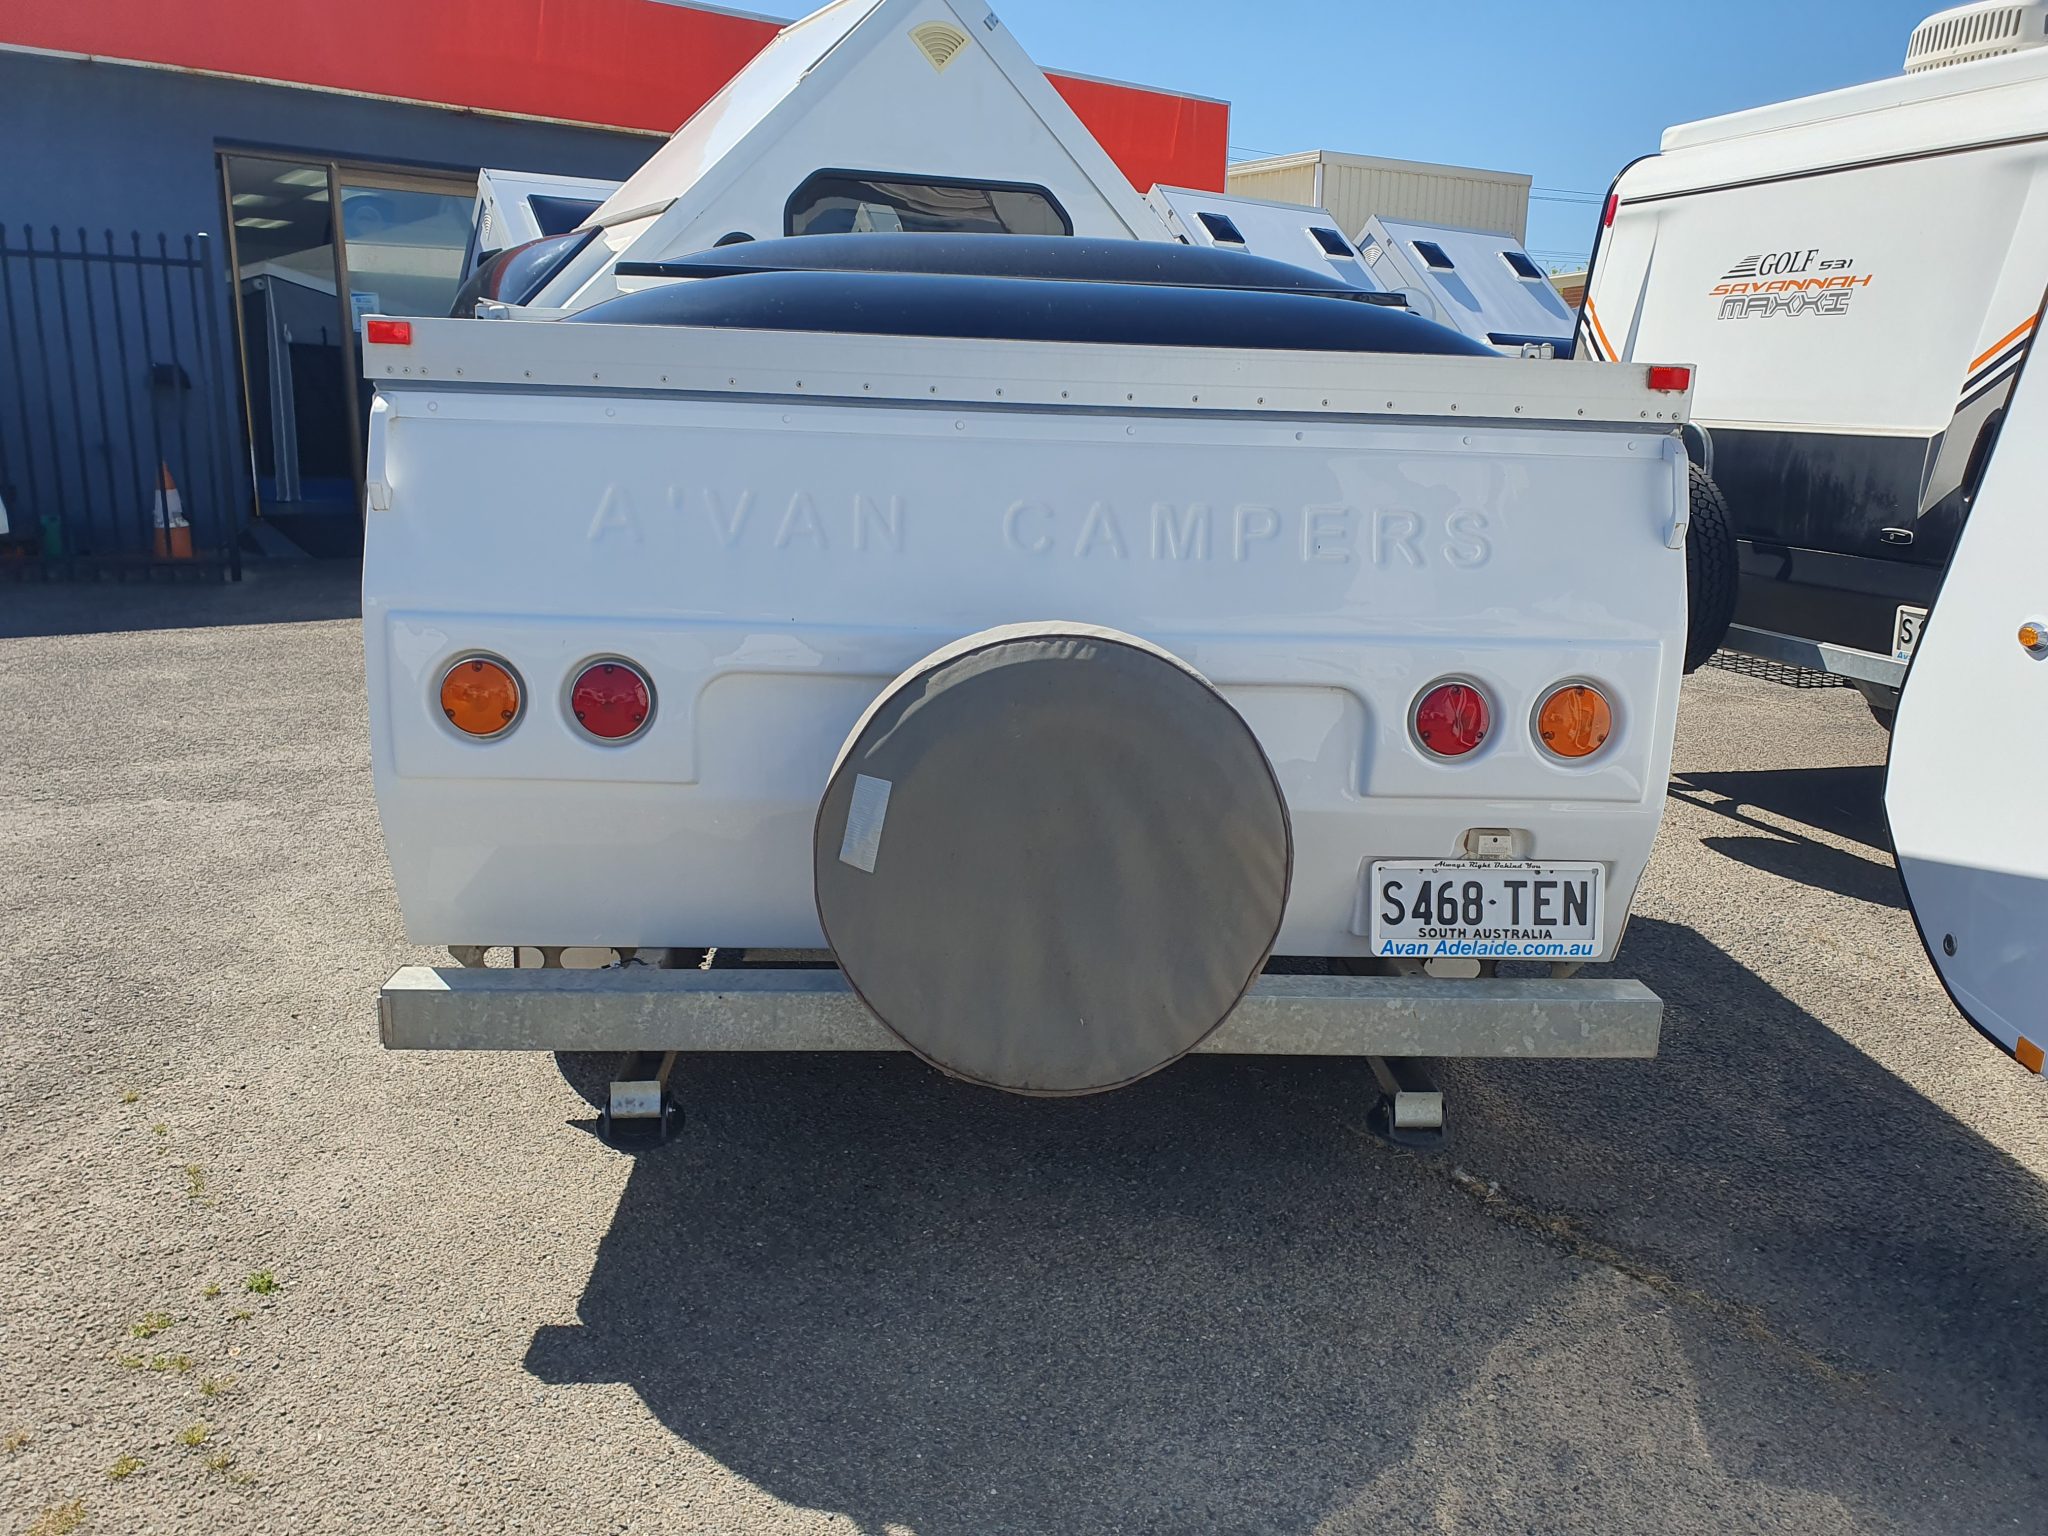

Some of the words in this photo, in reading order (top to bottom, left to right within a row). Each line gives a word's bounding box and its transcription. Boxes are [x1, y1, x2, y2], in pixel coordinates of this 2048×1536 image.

[1758, 249, 1820, 276] GOLF
[1818, 258, 1854, 271] 531
[1709, 274, 1873, 296] SAVANNAH
[1718, 288, 1854, 320] MAXXI
[586, 481, 907, 553] A'VAN
[1001, 499, 1495, 569] CAMPERS
[1434, 860, 1466, 869] Always
[1469, 861, 1491, 869] Right
[1494, 861, 1523, 869] Behind
[1418, 927, 1467, 939] SOUTH
[1472, 928, 1553, 939] AUSTRALIA
[1380, 939, 1429, 955] Avan
[1433, 939, 1593, 956] Adelaide.com.au
